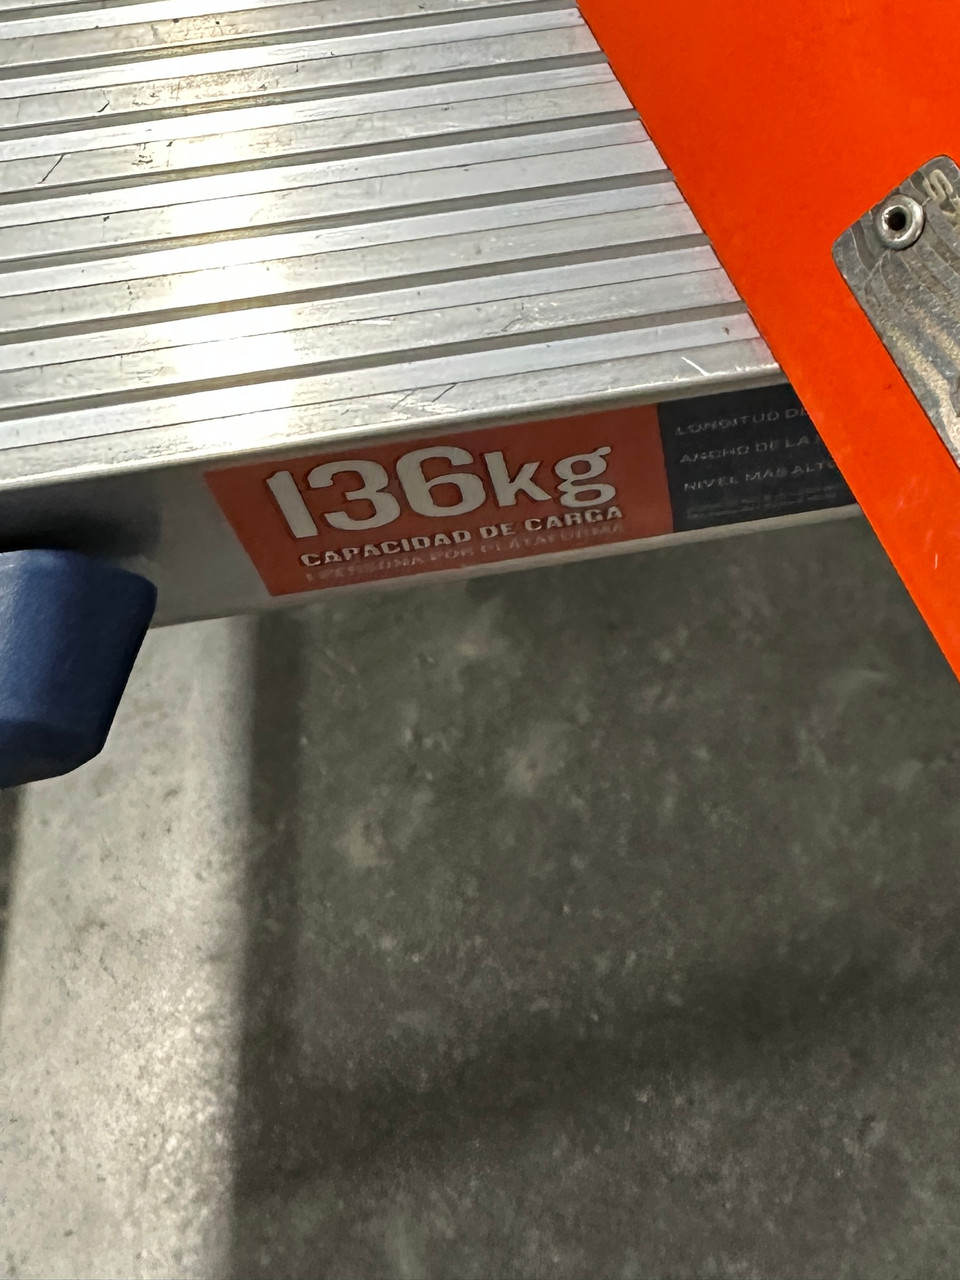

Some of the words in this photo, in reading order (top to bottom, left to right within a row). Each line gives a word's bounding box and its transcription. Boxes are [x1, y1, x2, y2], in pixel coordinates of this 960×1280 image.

[785, 435, 811, 448] LA
[684, 475, 738, 491] NIVEL
[300, 529, 473, 567] CAPACIDAD
[480, 523, 517, 540] DE
[524, 505, 624, 532] CARGA
